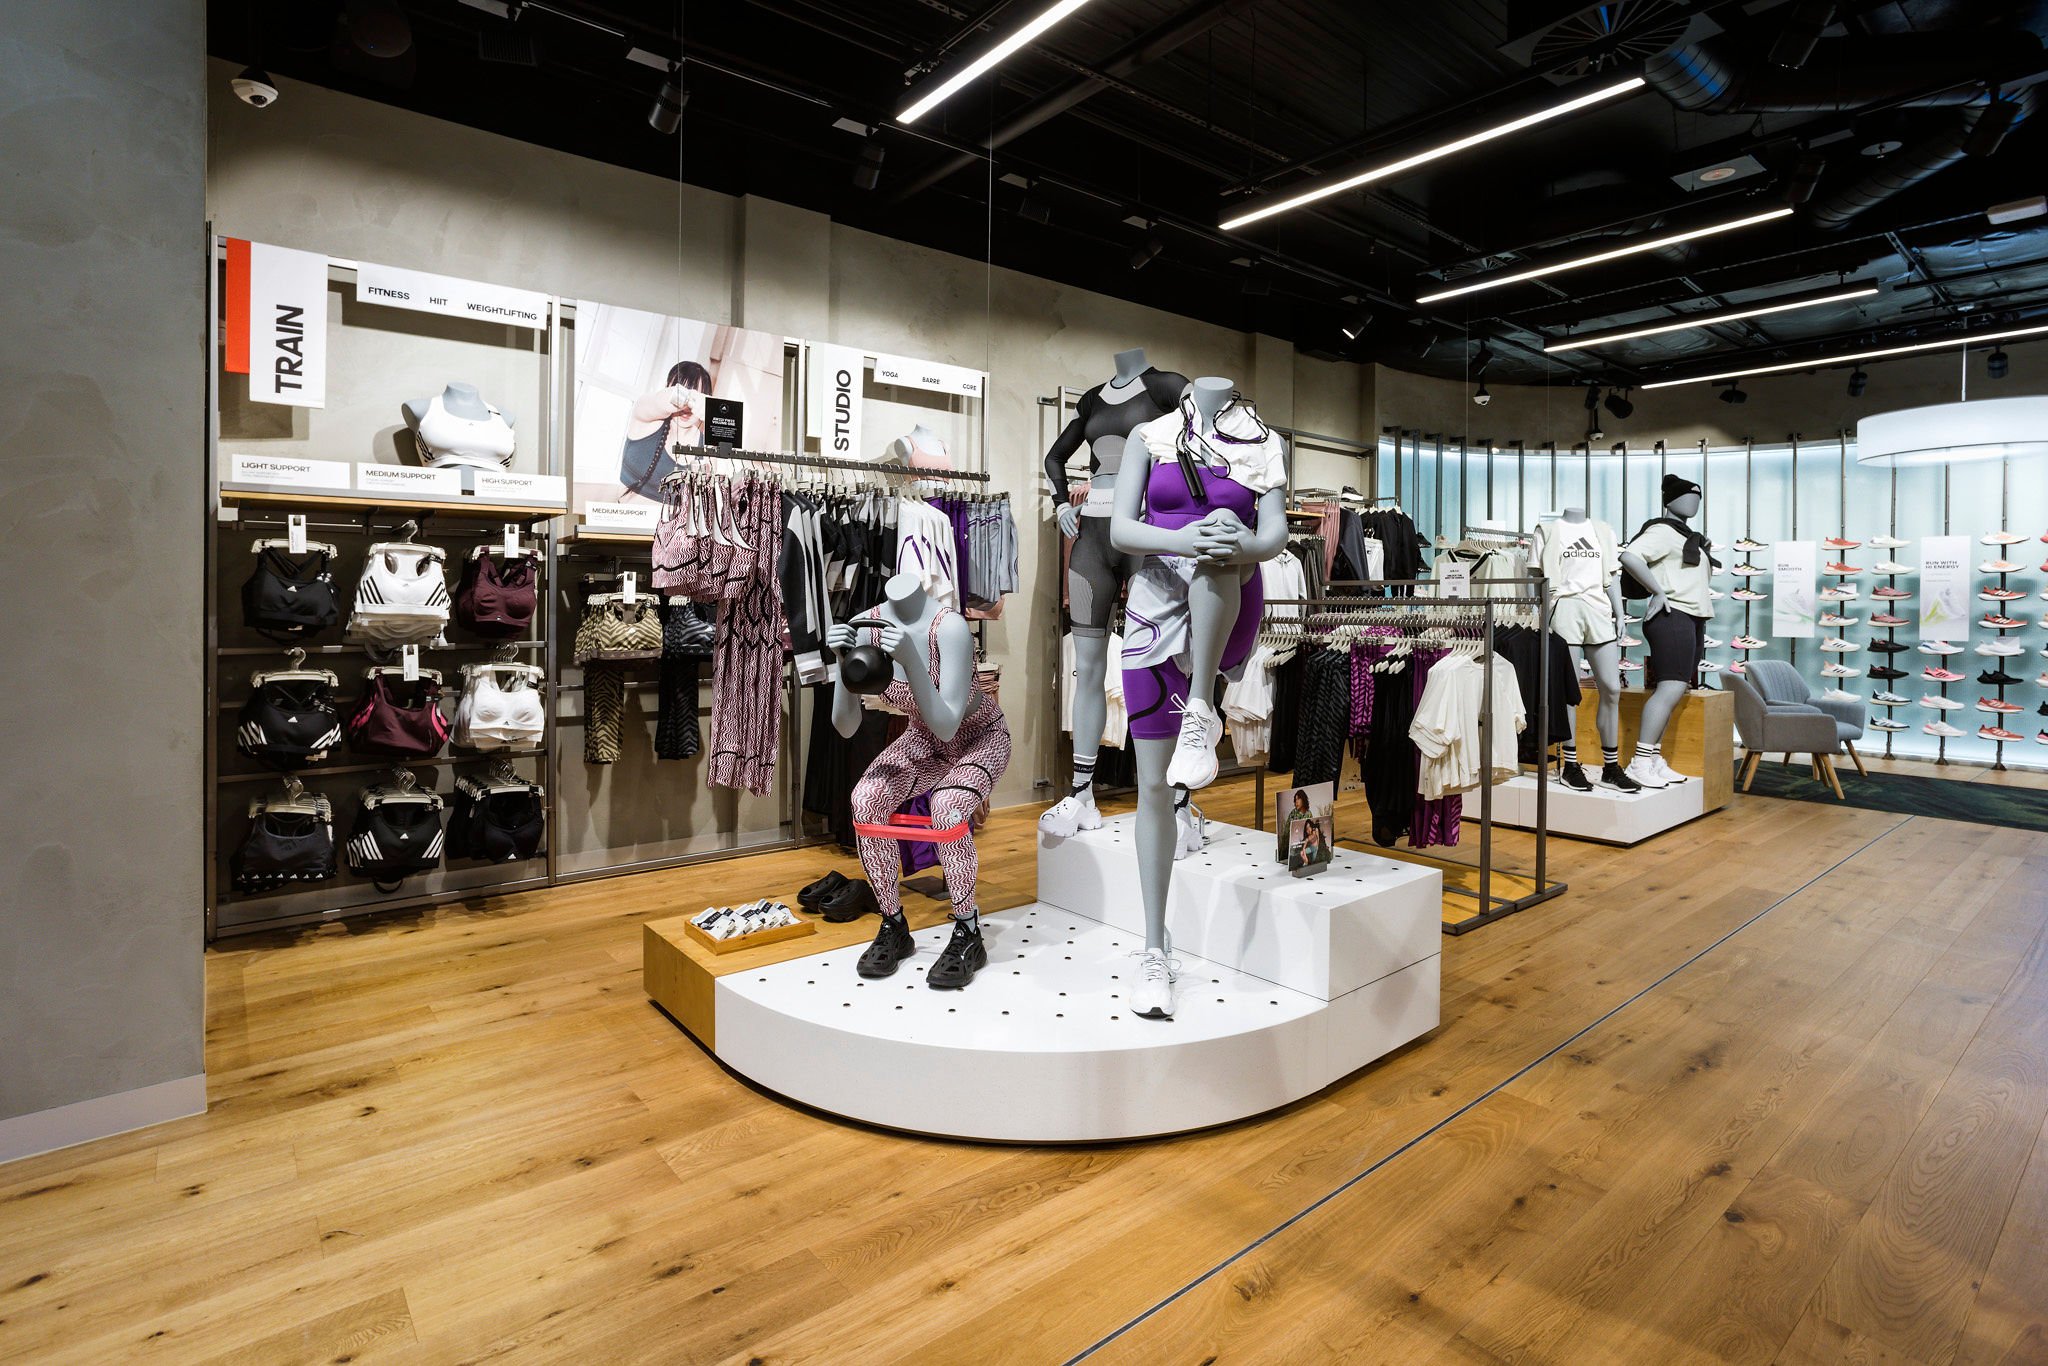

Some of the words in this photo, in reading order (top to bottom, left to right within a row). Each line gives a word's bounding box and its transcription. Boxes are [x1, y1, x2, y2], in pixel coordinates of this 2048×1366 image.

[368, 286, 410, 300] FITNESS
[429, 296, 449, 306] HIIT
[467, 302, 538, 321] WEIGHTLIFTING
[275, 304, 304, 394] TRAIN
[882, 370, 899, 378] YOGA
[922, 376, 941, 385] BARRE
[962, 383, 977, 391] CORE
[834, 369, 852, 452] STUDIO
[241, 462, 269, 470] LIGHT
[269, 463, 311, 473] SUPPORT
[366, 470, 400, 478] MEDIUM
[400, 471, 436, 480] SUPPORT
[500, 478, 533, 486] SUPPORT
[1562, 549, 1600, 559] adidas
